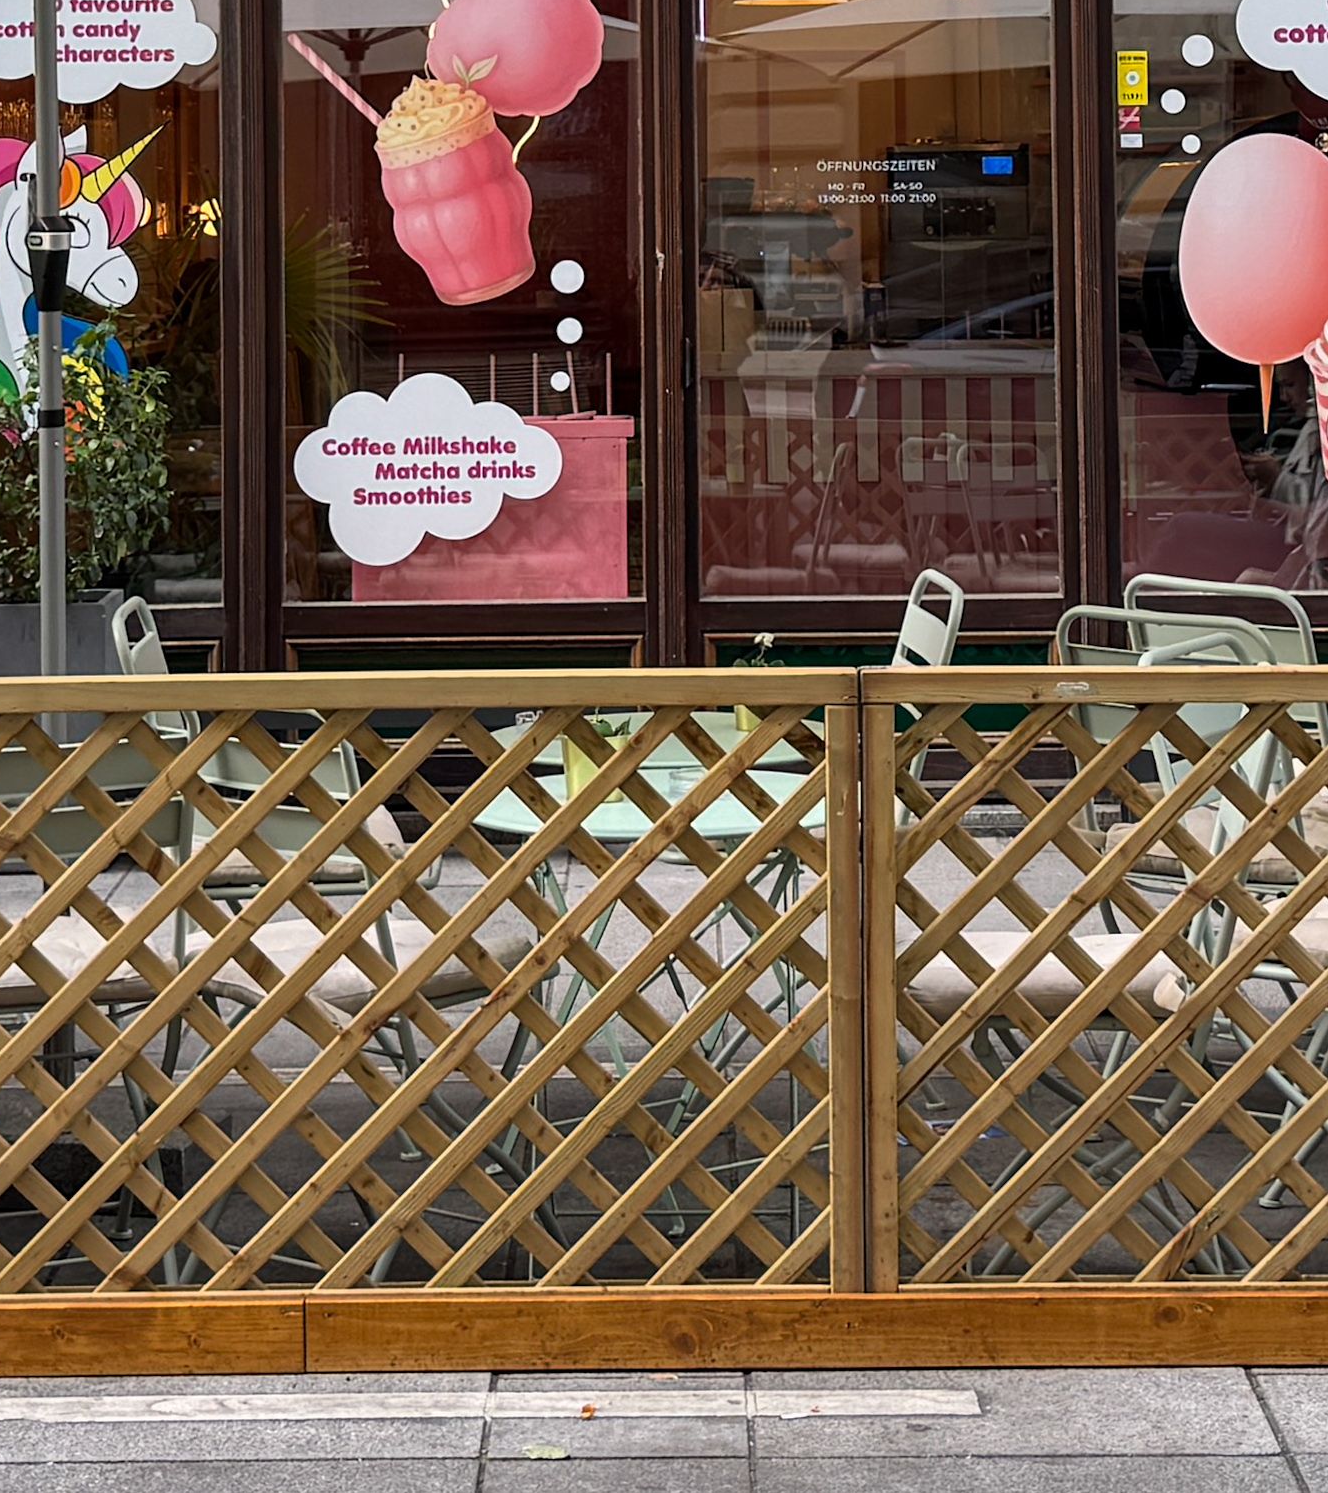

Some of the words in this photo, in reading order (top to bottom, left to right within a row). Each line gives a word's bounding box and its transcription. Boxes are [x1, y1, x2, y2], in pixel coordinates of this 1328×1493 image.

[72, 19, 141, 43] candy
[816, 158, 937, 172] ÖFFNUNGSZEITEN
[322, 437, 396, 456] Coffee
[403, 435, 517, 455] Milkshake
[375, 461, 461, 480] Matcha
[467, 460, 536, 479] drinks
[353, 485, 472, 505] Smoothies
